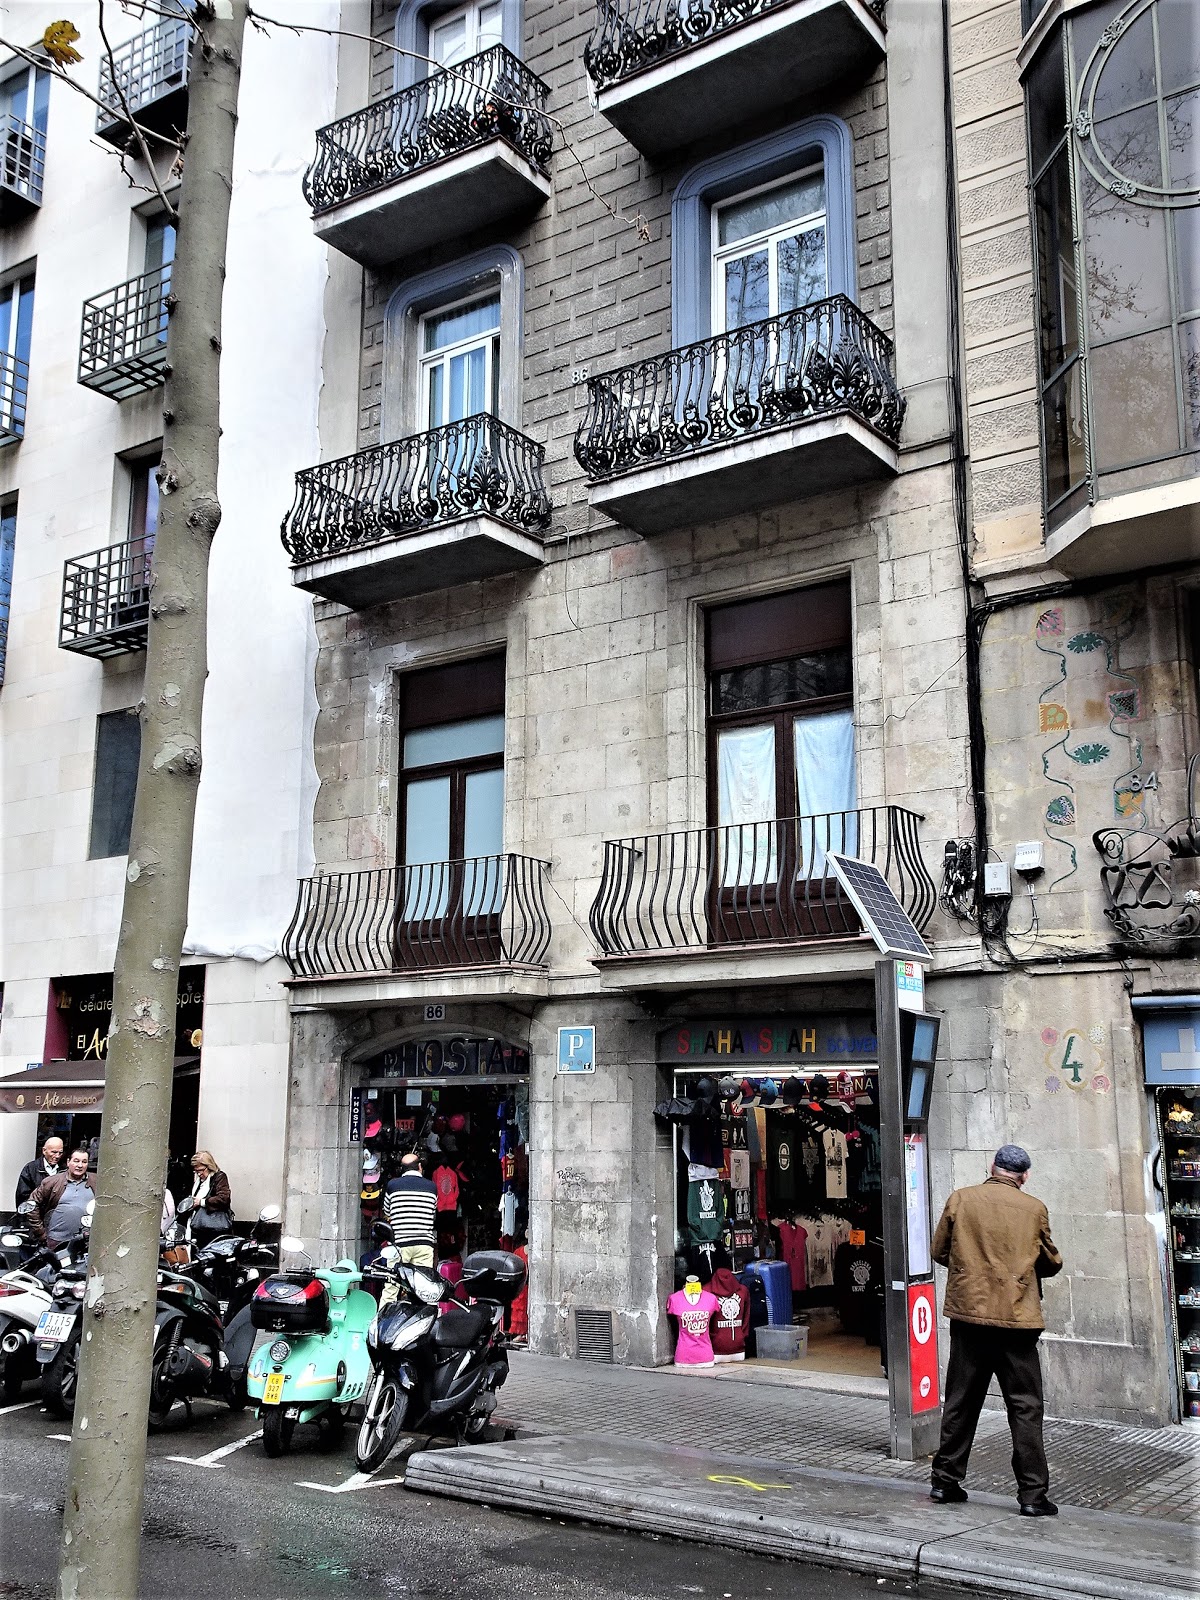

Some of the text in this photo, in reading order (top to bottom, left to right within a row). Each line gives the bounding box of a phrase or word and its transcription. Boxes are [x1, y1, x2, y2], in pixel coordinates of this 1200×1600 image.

[572, 368, 588, 384] 86
[1130, 771, 1158, 792] 84
[427, 1006, 443, 1019] 86
[77, 1034, 86, 1049] El
[568, 1034, 584, 1058] P
[677, 1028, 816, 1054] SHAHANSHAH
[401, 1038, 529, 1078] HOSTAL
[36, 1091, 97, 1111] El Arte del helado
[352, 1101, 360, 1141] HOSTAL
[507, 1164, 515, 1178] 10
[43, 1325, 64, 1336] GHN
